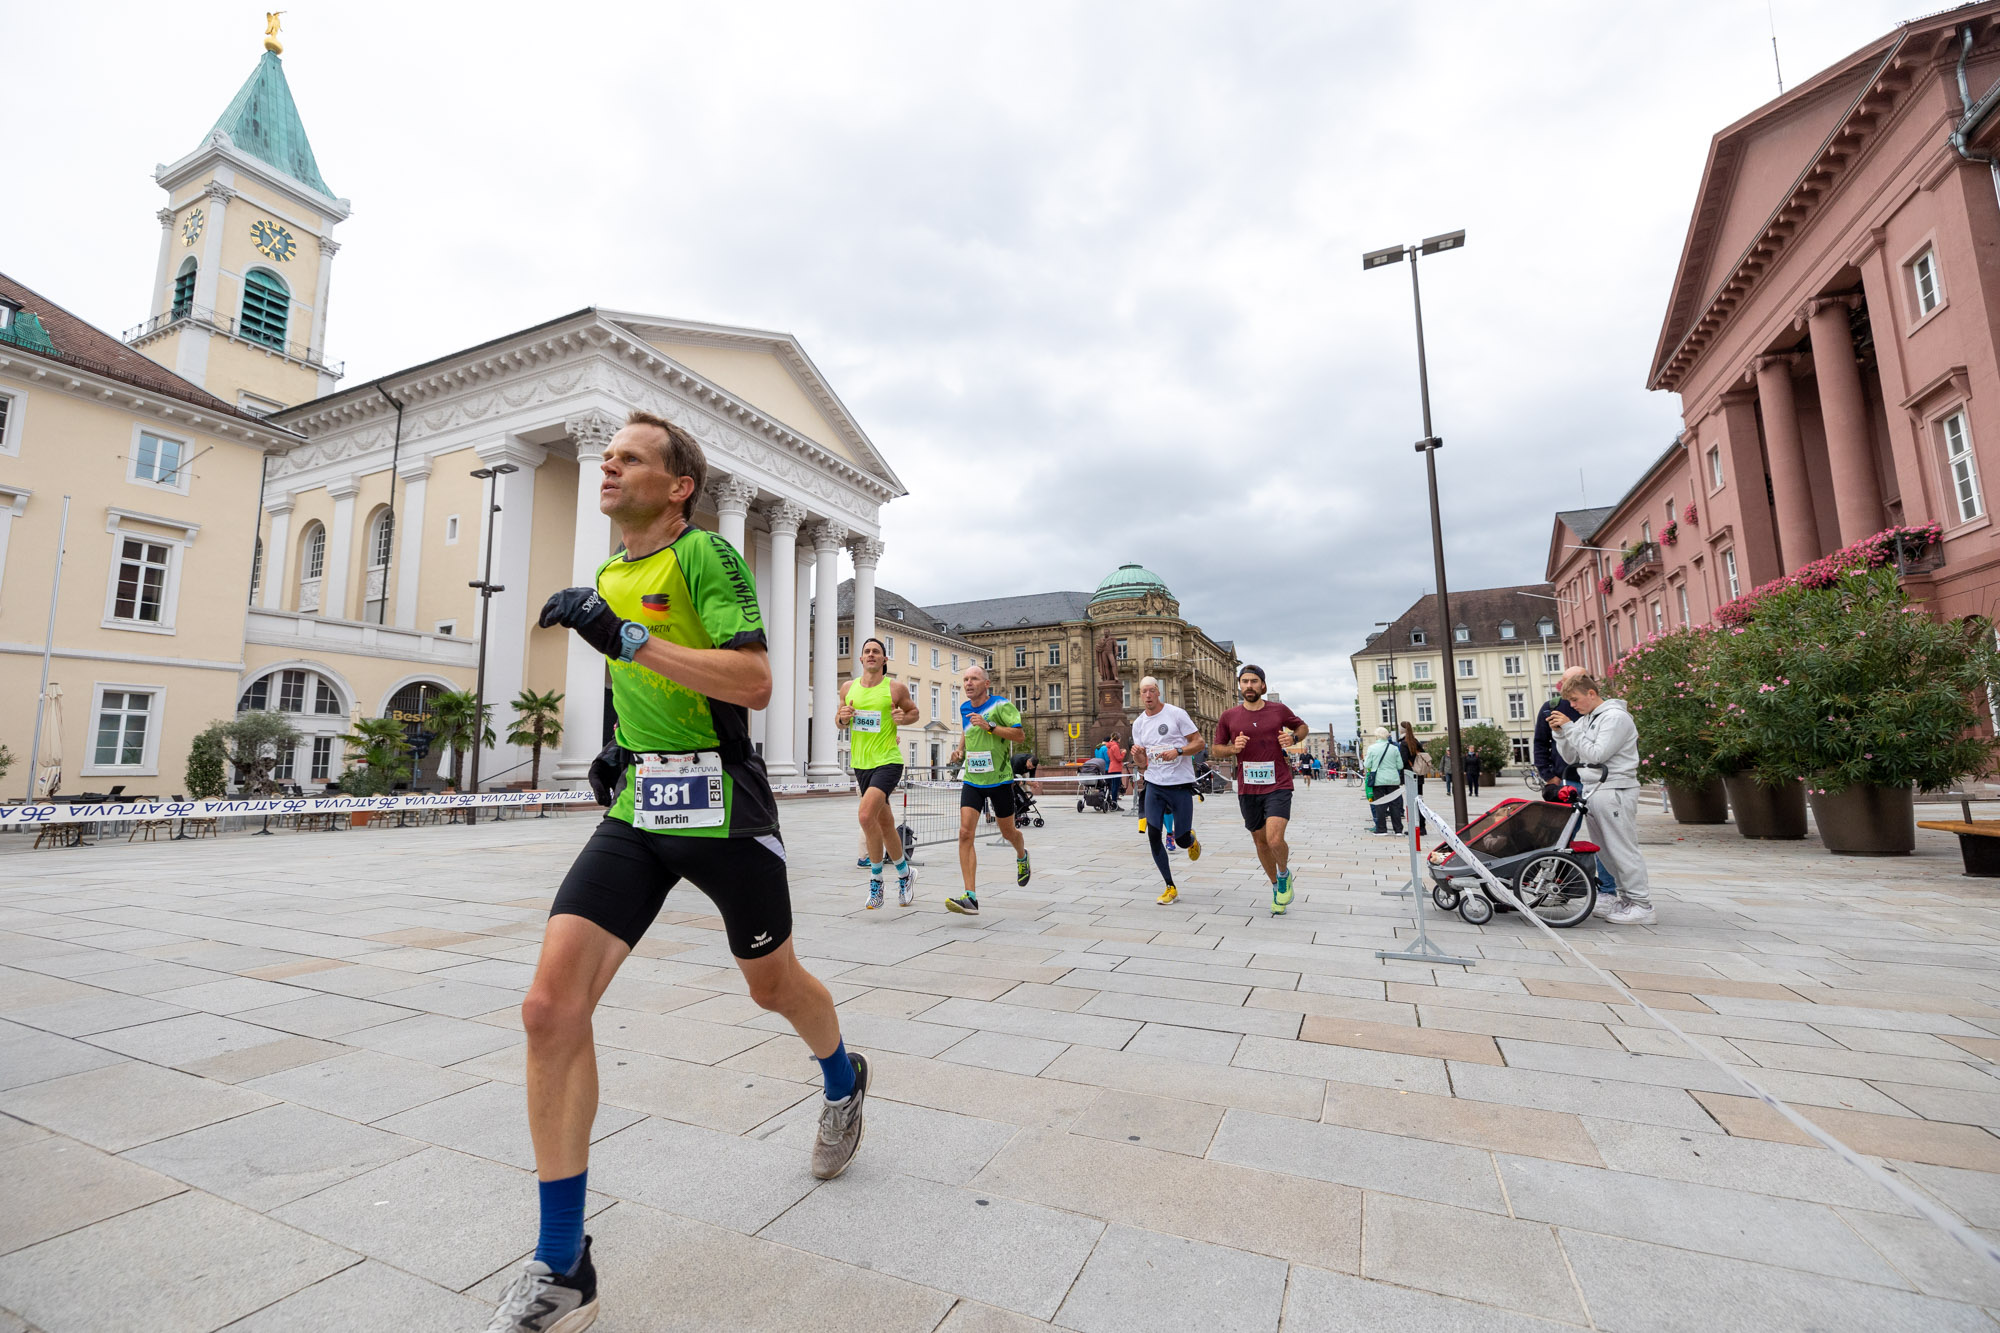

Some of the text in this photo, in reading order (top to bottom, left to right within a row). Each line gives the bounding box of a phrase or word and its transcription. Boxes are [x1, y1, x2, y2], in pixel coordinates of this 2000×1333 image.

[1068, 723, 1080, 739] U
[649, 782, 691, 806] 381
[205, 800, 282, 812] ATRUVIA
[314, 797, 379, 809] ATRUVIA
[405, 795, 460, 806] ATRUVIA
[70, 803, 164, 817] ATRUVIA
[654, 814, 689, 825] Martin
